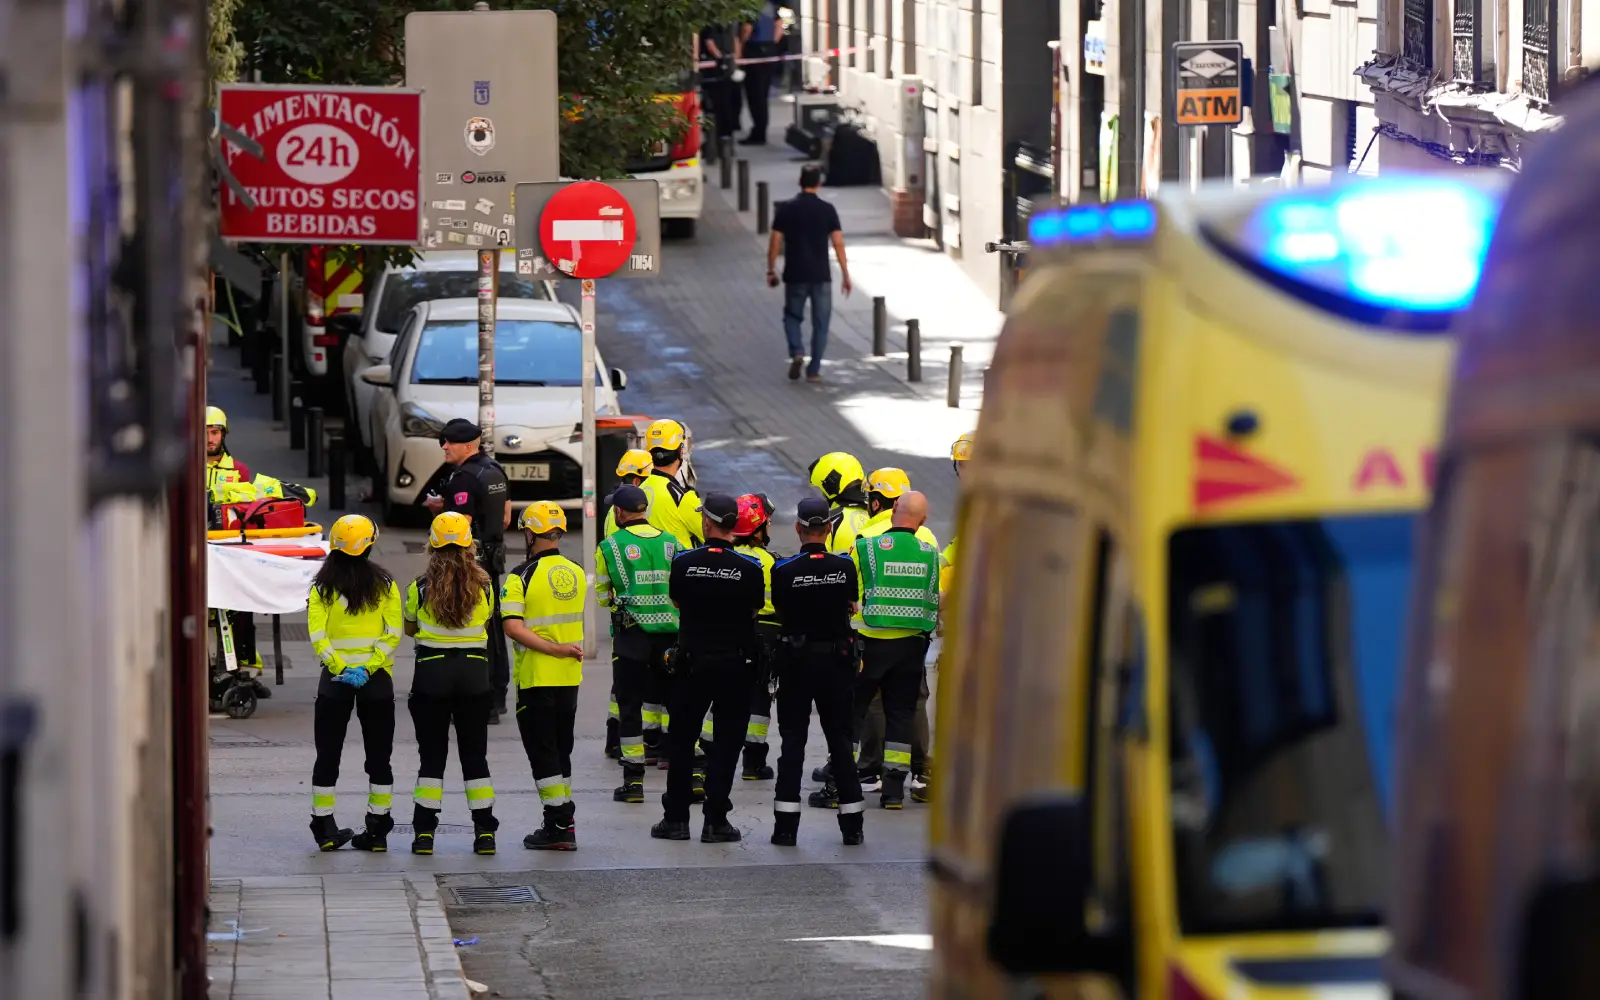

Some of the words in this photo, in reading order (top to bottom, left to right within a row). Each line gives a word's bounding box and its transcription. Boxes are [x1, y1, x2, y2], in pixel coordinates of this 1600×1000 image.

[1180, 96, 1237, 117] ATM
[285, 136, 351, 167] 24h
[477, 175, 506, 183] MOSA
[332, 188, 415, 210] SECOS
[266, 213, 377, 236] BEBIDAS
[521, 465, 544, 478] JZL
[686, 566, 742, 577] POLICÍA
[793, 570, 847, 583] POLICÍA
